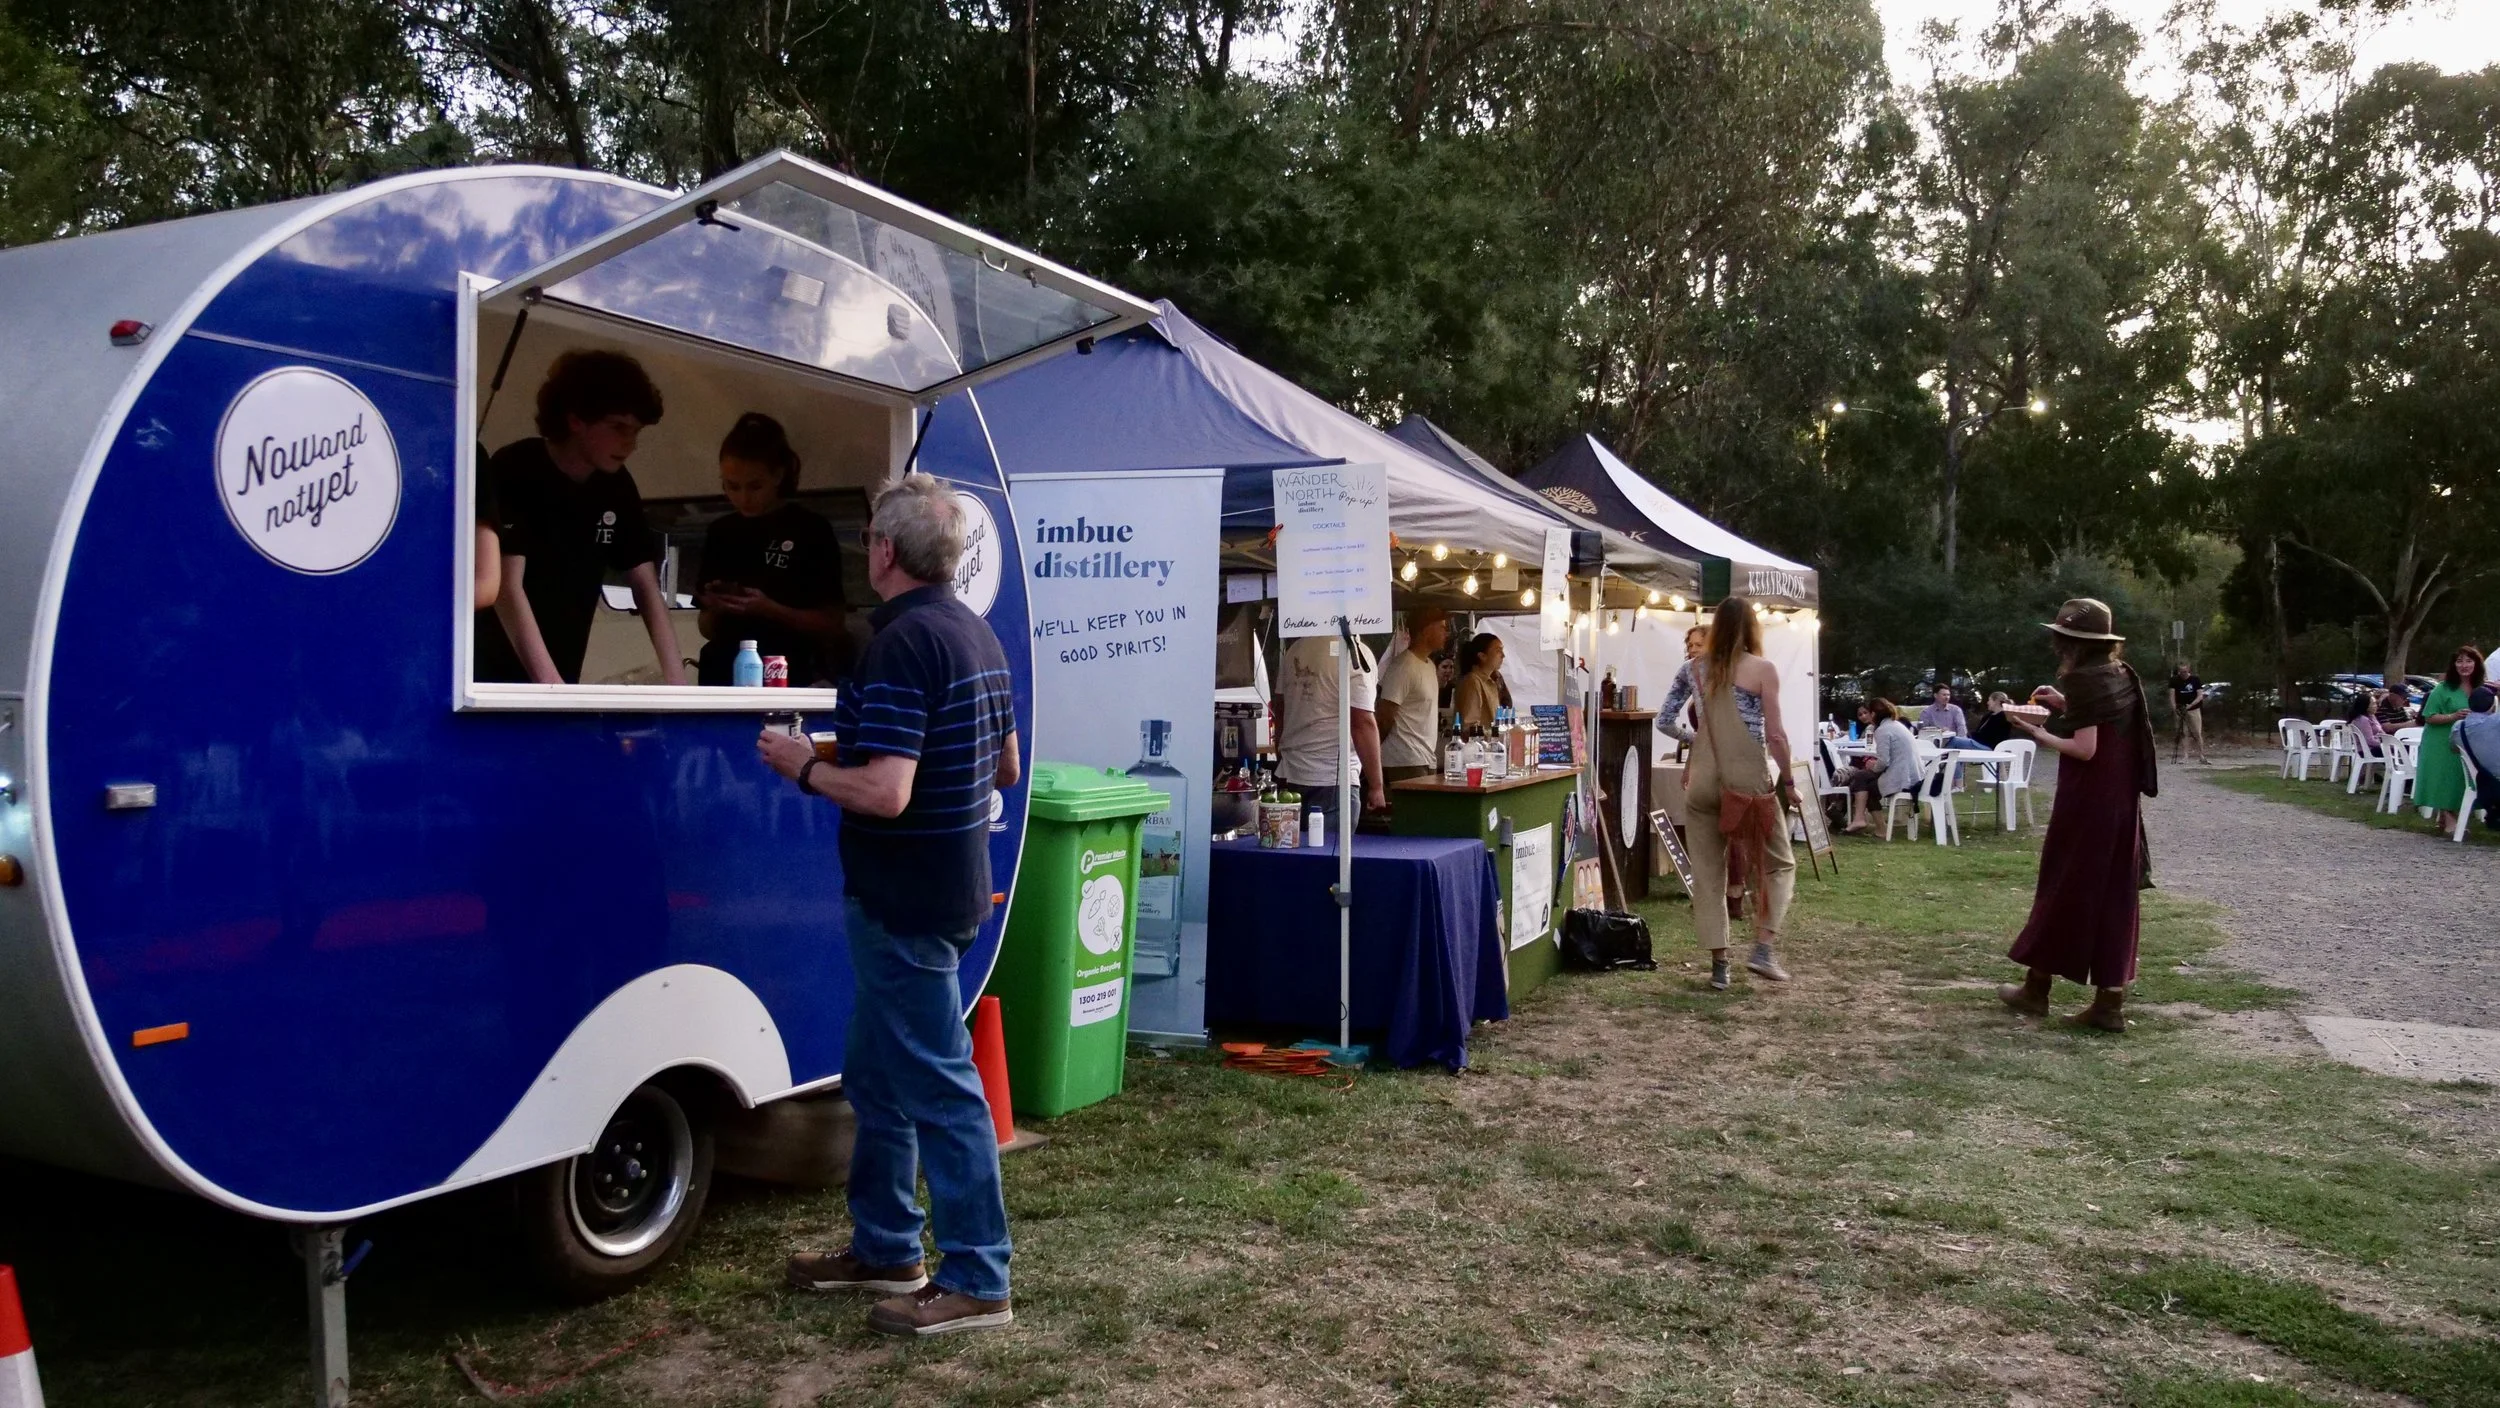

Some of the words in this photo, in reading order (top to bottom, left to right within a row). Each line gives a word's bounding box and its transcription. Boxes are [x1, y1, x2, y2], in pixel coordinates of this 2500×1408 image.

[1276, 472, 1347, 488] WANDER
[1283, 488, 1335, 504] NORTH
[1338, 491, 1356, 506] Pop
[1036, 516, 1133, 544] imbue
[1312, 522, 1346, 530] COCKTAILS
[1034, 551, 1175, 587] distillery
[1748, 570, 1806, 599] KELLYBROOK
[1087, 613, 1127, 632] KEEP
[1135, 608, 1164, 626] YOU
[1172, 605, 1186, 620] IN
[1283, 617, 1318, 629] Order
[1060, 645, 1098, 663] GOOD
[1106, 635, 1166, 659] SPIRITS!
[1145, 816, 1171, 825] RBAN
[1076, 967, 1100, 979] Organic
[1079, 995, 1096, 1005] 1300
[1096, 991, 1107, 1001] 219
[1107, 988, 1117, 998] 001
